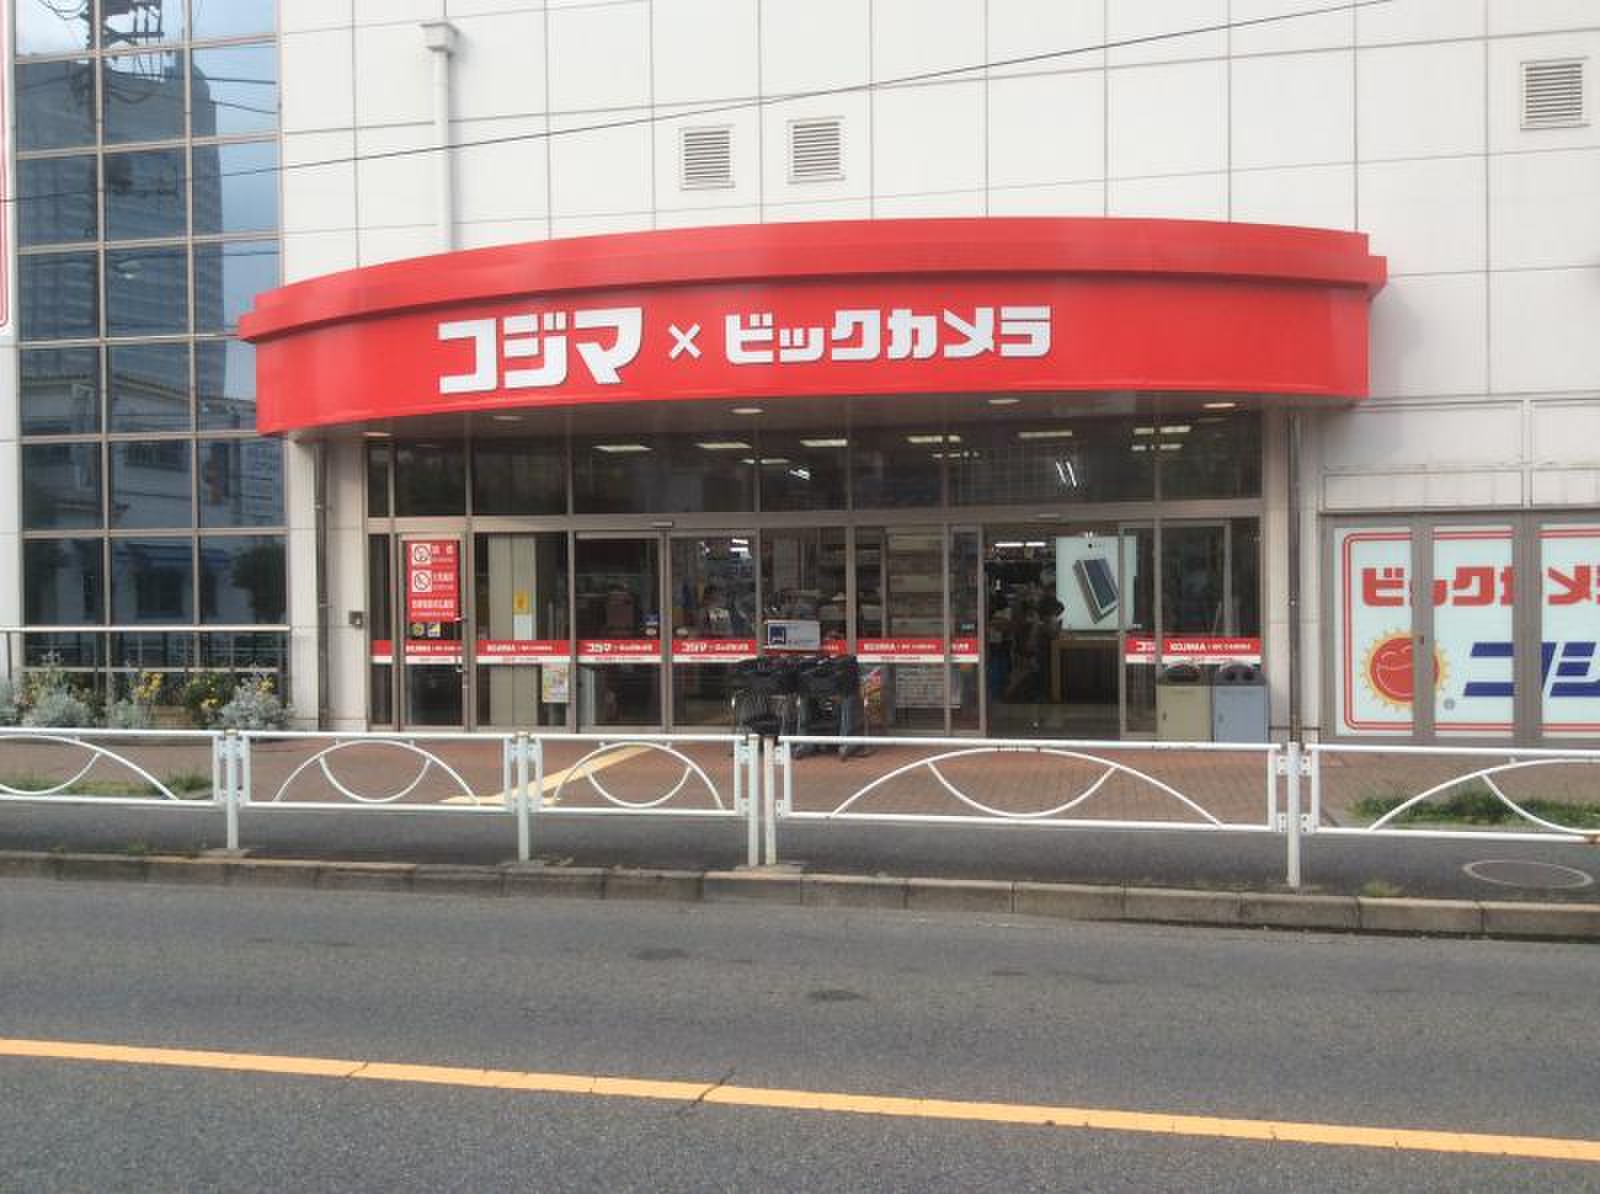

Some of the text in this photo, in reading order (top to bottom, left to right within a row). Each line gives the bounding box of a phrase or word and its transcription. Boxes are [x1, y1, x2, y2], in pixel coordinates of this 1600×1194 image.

[437, 306, 643, 394] コジマ
[725, 304, 1052, 364] ビックカメラ
